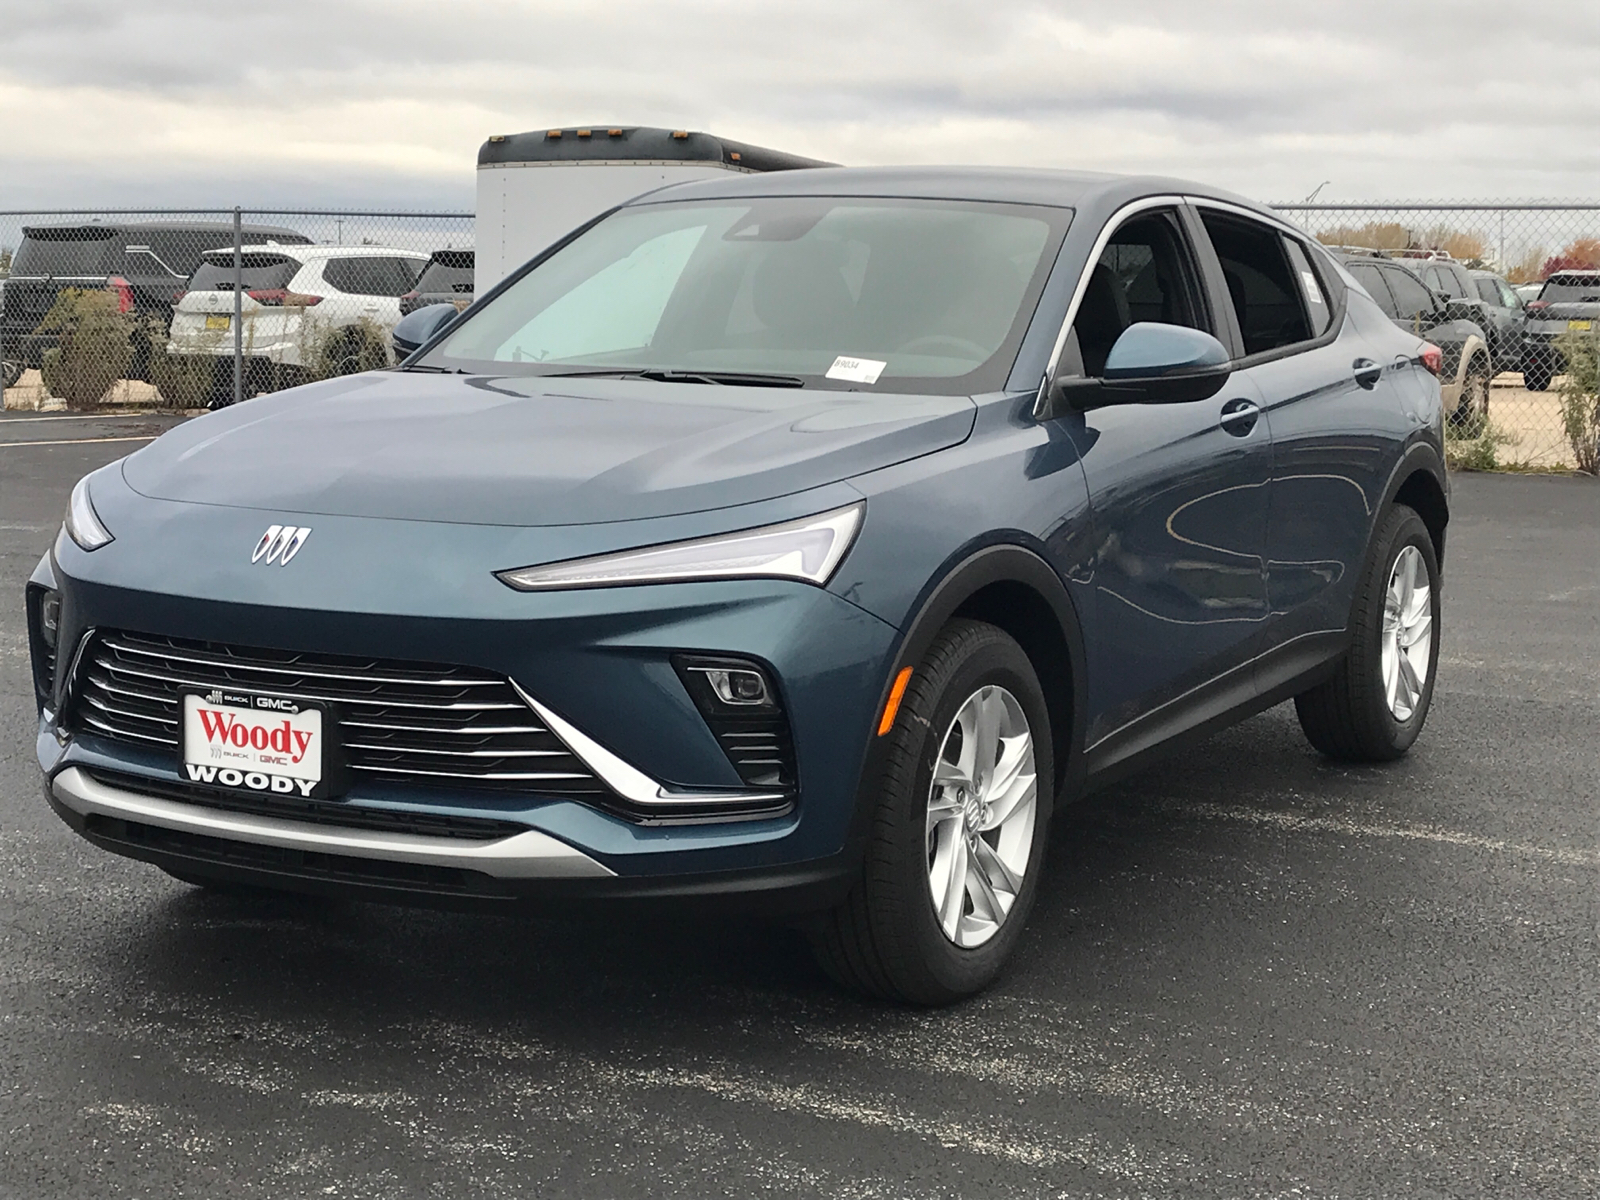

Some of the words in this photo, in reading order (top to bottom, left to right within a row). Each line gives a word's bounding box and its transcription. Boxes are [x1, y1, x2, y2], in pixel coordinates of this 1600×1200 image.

[224, 695, 249, 704] BUICK
[256, 697, 292, 710] GMC
[196, 708, 313, 764] Woody
[223, 751, 249, 760] BUICK
[260, 755, 288, 766] GMC
[185, 764, 318, 797] WOODY
